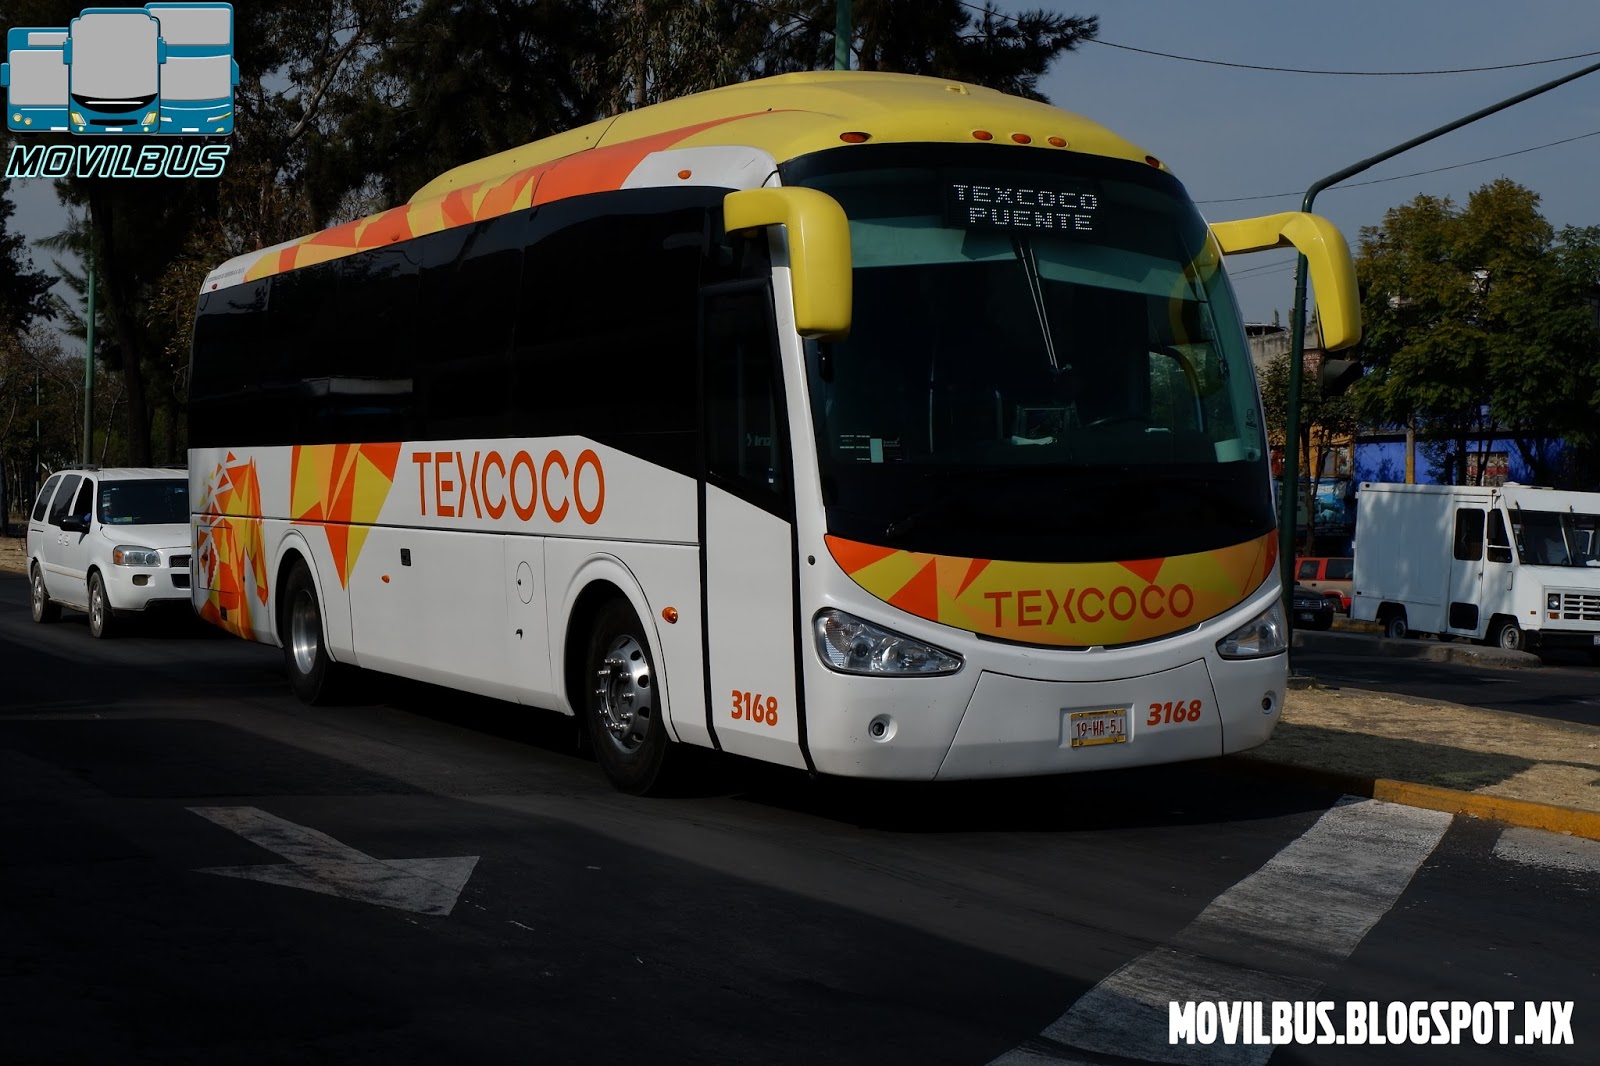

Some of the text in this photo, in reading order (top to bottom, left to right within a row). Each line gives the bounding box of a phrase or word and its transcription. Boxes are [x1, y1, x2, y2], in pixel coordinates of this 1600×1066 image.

[953, 184, 1097, 209] TEXCOCO
[970, 207, 1093, 230] PUENTE
[412, 449, 605, 524] TEXCOCO
[984, 583, 1194, 628] TEXCOCO
[731, 690, 778, 726] 3168
[1147, 700, 1202, 726] 3168
[1076, 719, 1123, 737] 19-HA-5J
